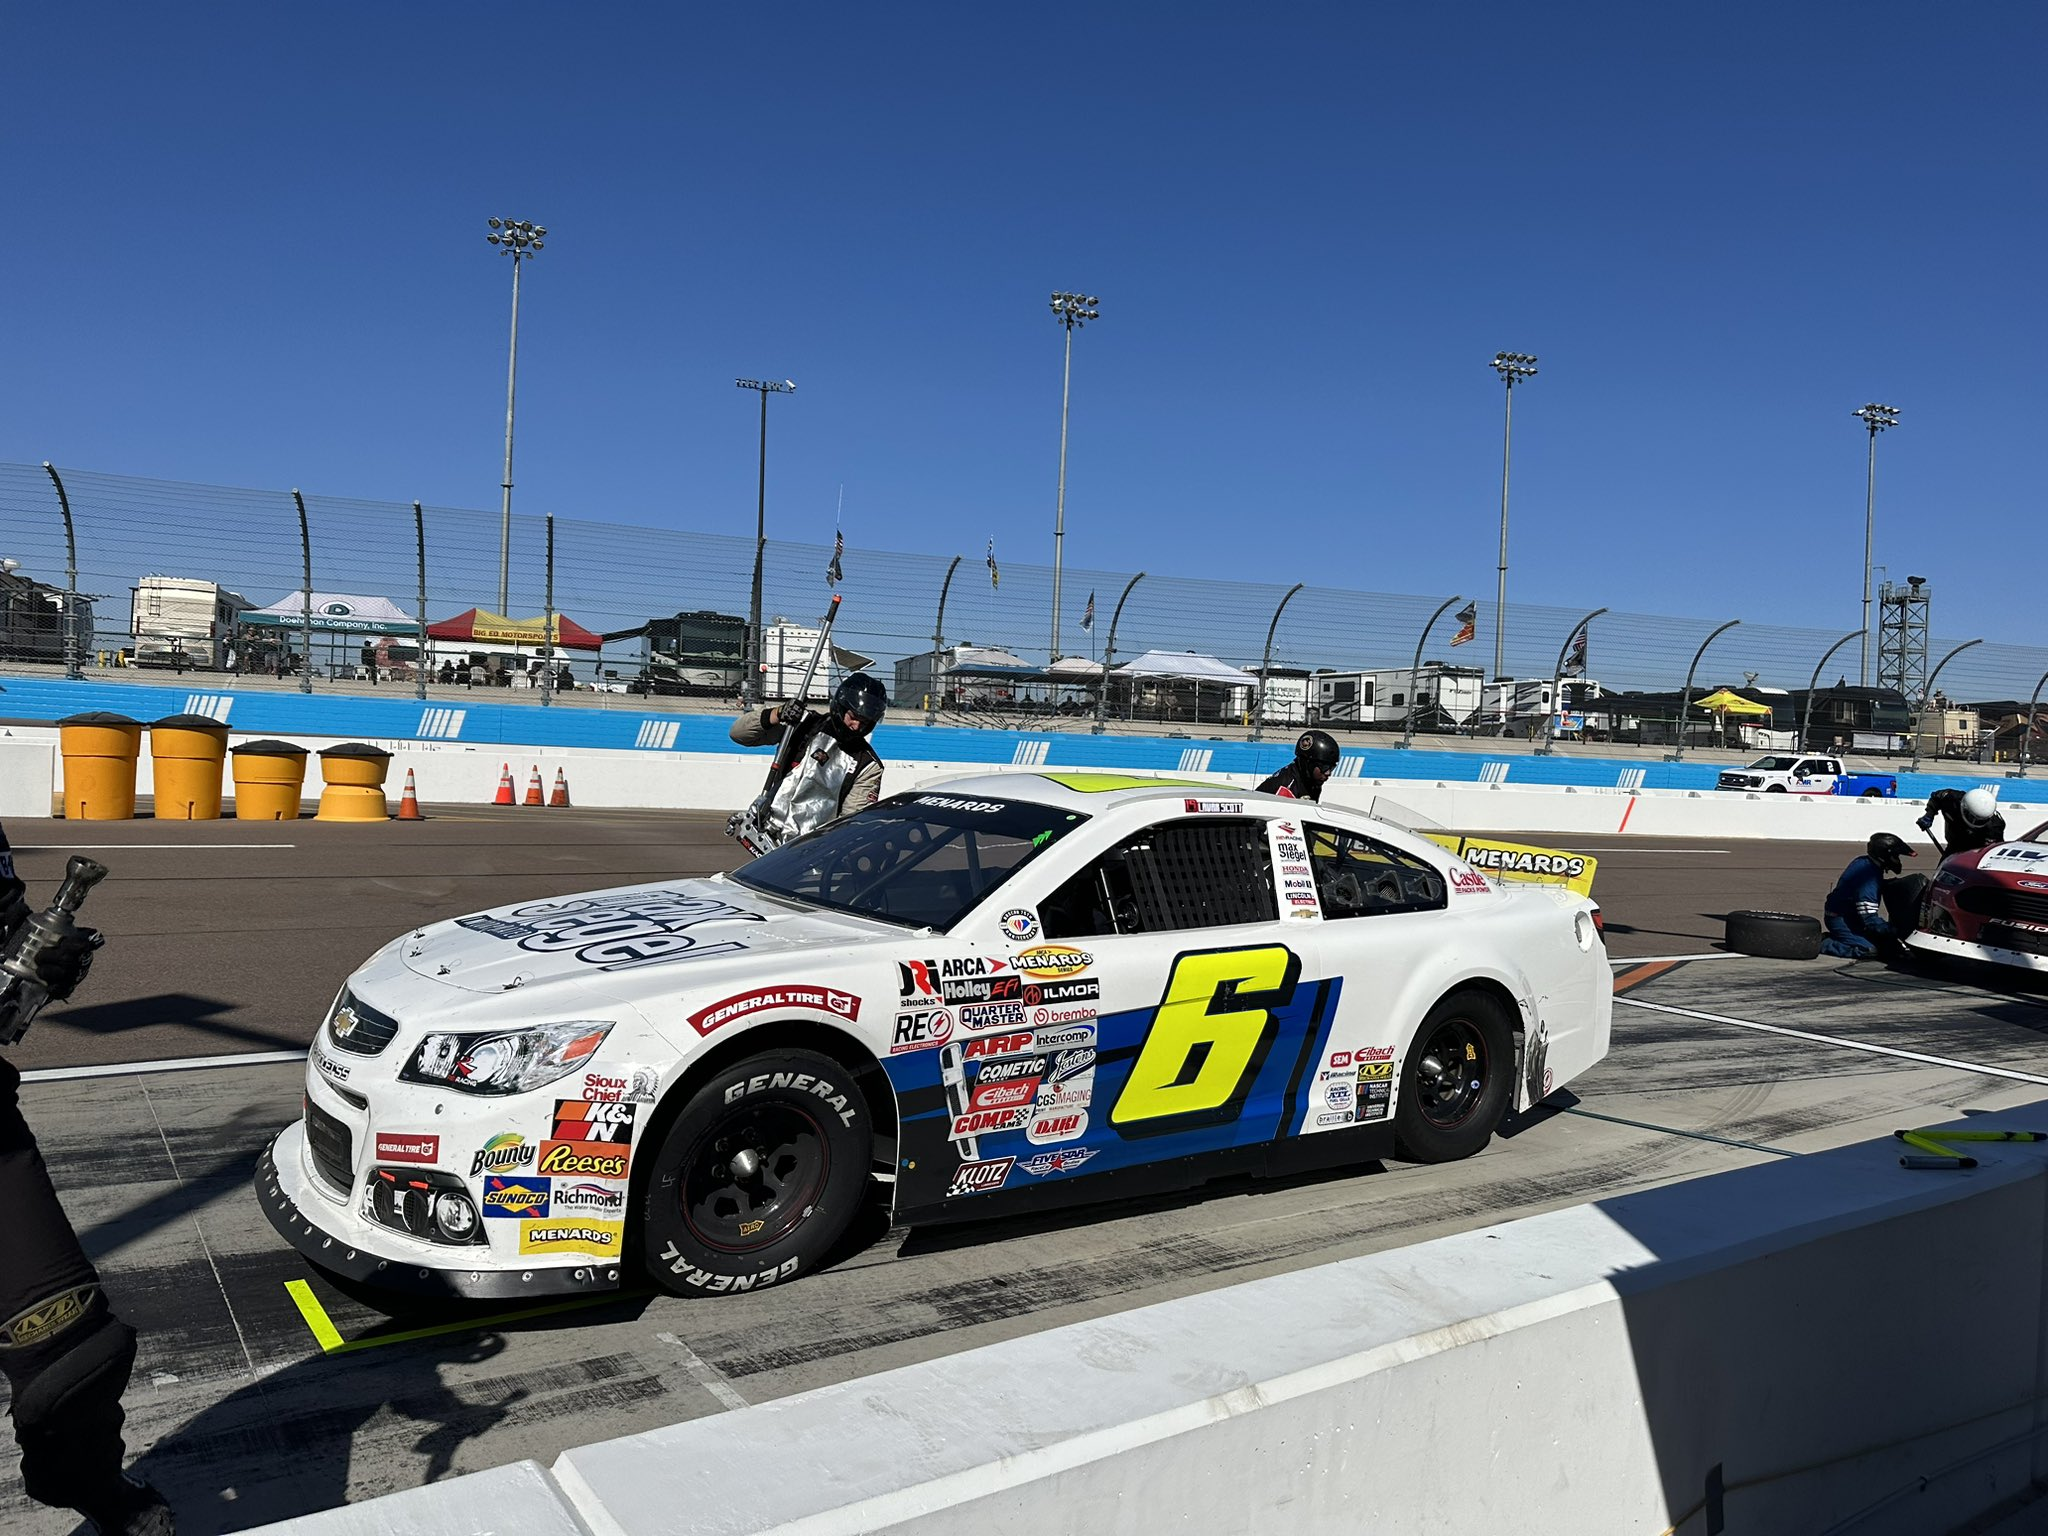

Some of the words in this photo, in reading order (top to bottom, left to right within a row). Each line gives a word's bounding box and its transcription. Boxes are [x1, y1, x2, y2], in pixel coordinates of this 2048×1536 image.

[326, 618, 370, 630] Company,
[501, 632, 559, 641] MOTORSPOS
[1826, 762, 1835, 772] 2
[913, 796, 1006, 813] MENARDS
[1220, 802, 1243, 813] SCOTT
[1278, 842, 1298, 852] max
[1280, 850, 1307, 862] Siegel
[1465, 847, 1585, 877] MENARDS
[1282, 865, 1309, 874] HONDA
[1449, 866, 1486, 887] Castle
[1284, 880, 1305, 889] Mobil
[1286, 892, 1312, 900] LINCOLN
[942, 957, 987, 977] ARCA
[1009, 952, 1094, 970] MENARDS
[943, 981, 990, 1001] Holley
[1043, 983, 1099, 999] ILMOR
[702, 992, 785, 1029] GENERAL
[786, 992, 824, 1005] TIRE
[900, 997, 936, 1007] shocks
[961, 1004, 1021, 1023] QUARTER
[972, 1012, 1024, 1029] MASTER
[1051, 1006, 1097, 1022] brembo
[1036, 1030, 1089, 1046] Intercomp
[1111, 947, 1289, 1124] 6
[964, 1033, 1033, 1060] ARP
[1354, 1046, 1395, 1062] Eibach
[1048, 1049, 1097, 1083] Jostens
[1332, 1054, 1349, 1065] SEM
[979, 1058, 1045, 1081] COMETIC
[584, 1073, 628, 1089] Sioux
[582, 1088, 622, 1102] Chief
[724, 1072, 857, 1128] GENERAL
[977, 1083, 1030, 1107] Eibach
[583, 1102, 633, 1125] K&
[954, 1109, 1016, 1134] COMP
[584, 1121, 619, 1142] N
[993, 1119, 1023, 1130] CAMS
[378, 1143, 405, 1153] GENERAL
[404, 1145, 421, 1154] TIRE
[469, 1143, 537, 1178] Bounty
[540, 1144, 627, 1176] Reese's
[1032, 1153, 1059, 1166] FIVE
[1061, 1149, 1086, 1159] STAR
[956, 1162, 1009, 1186] KLOTZ
[486, 1192, 547, 1205] SUNOCO
[554, 1188, 624, 1207] Richmond
[530, 1227, 613, 1244] MENARDS
[660, 1240, 799, 1292] GENERAL
